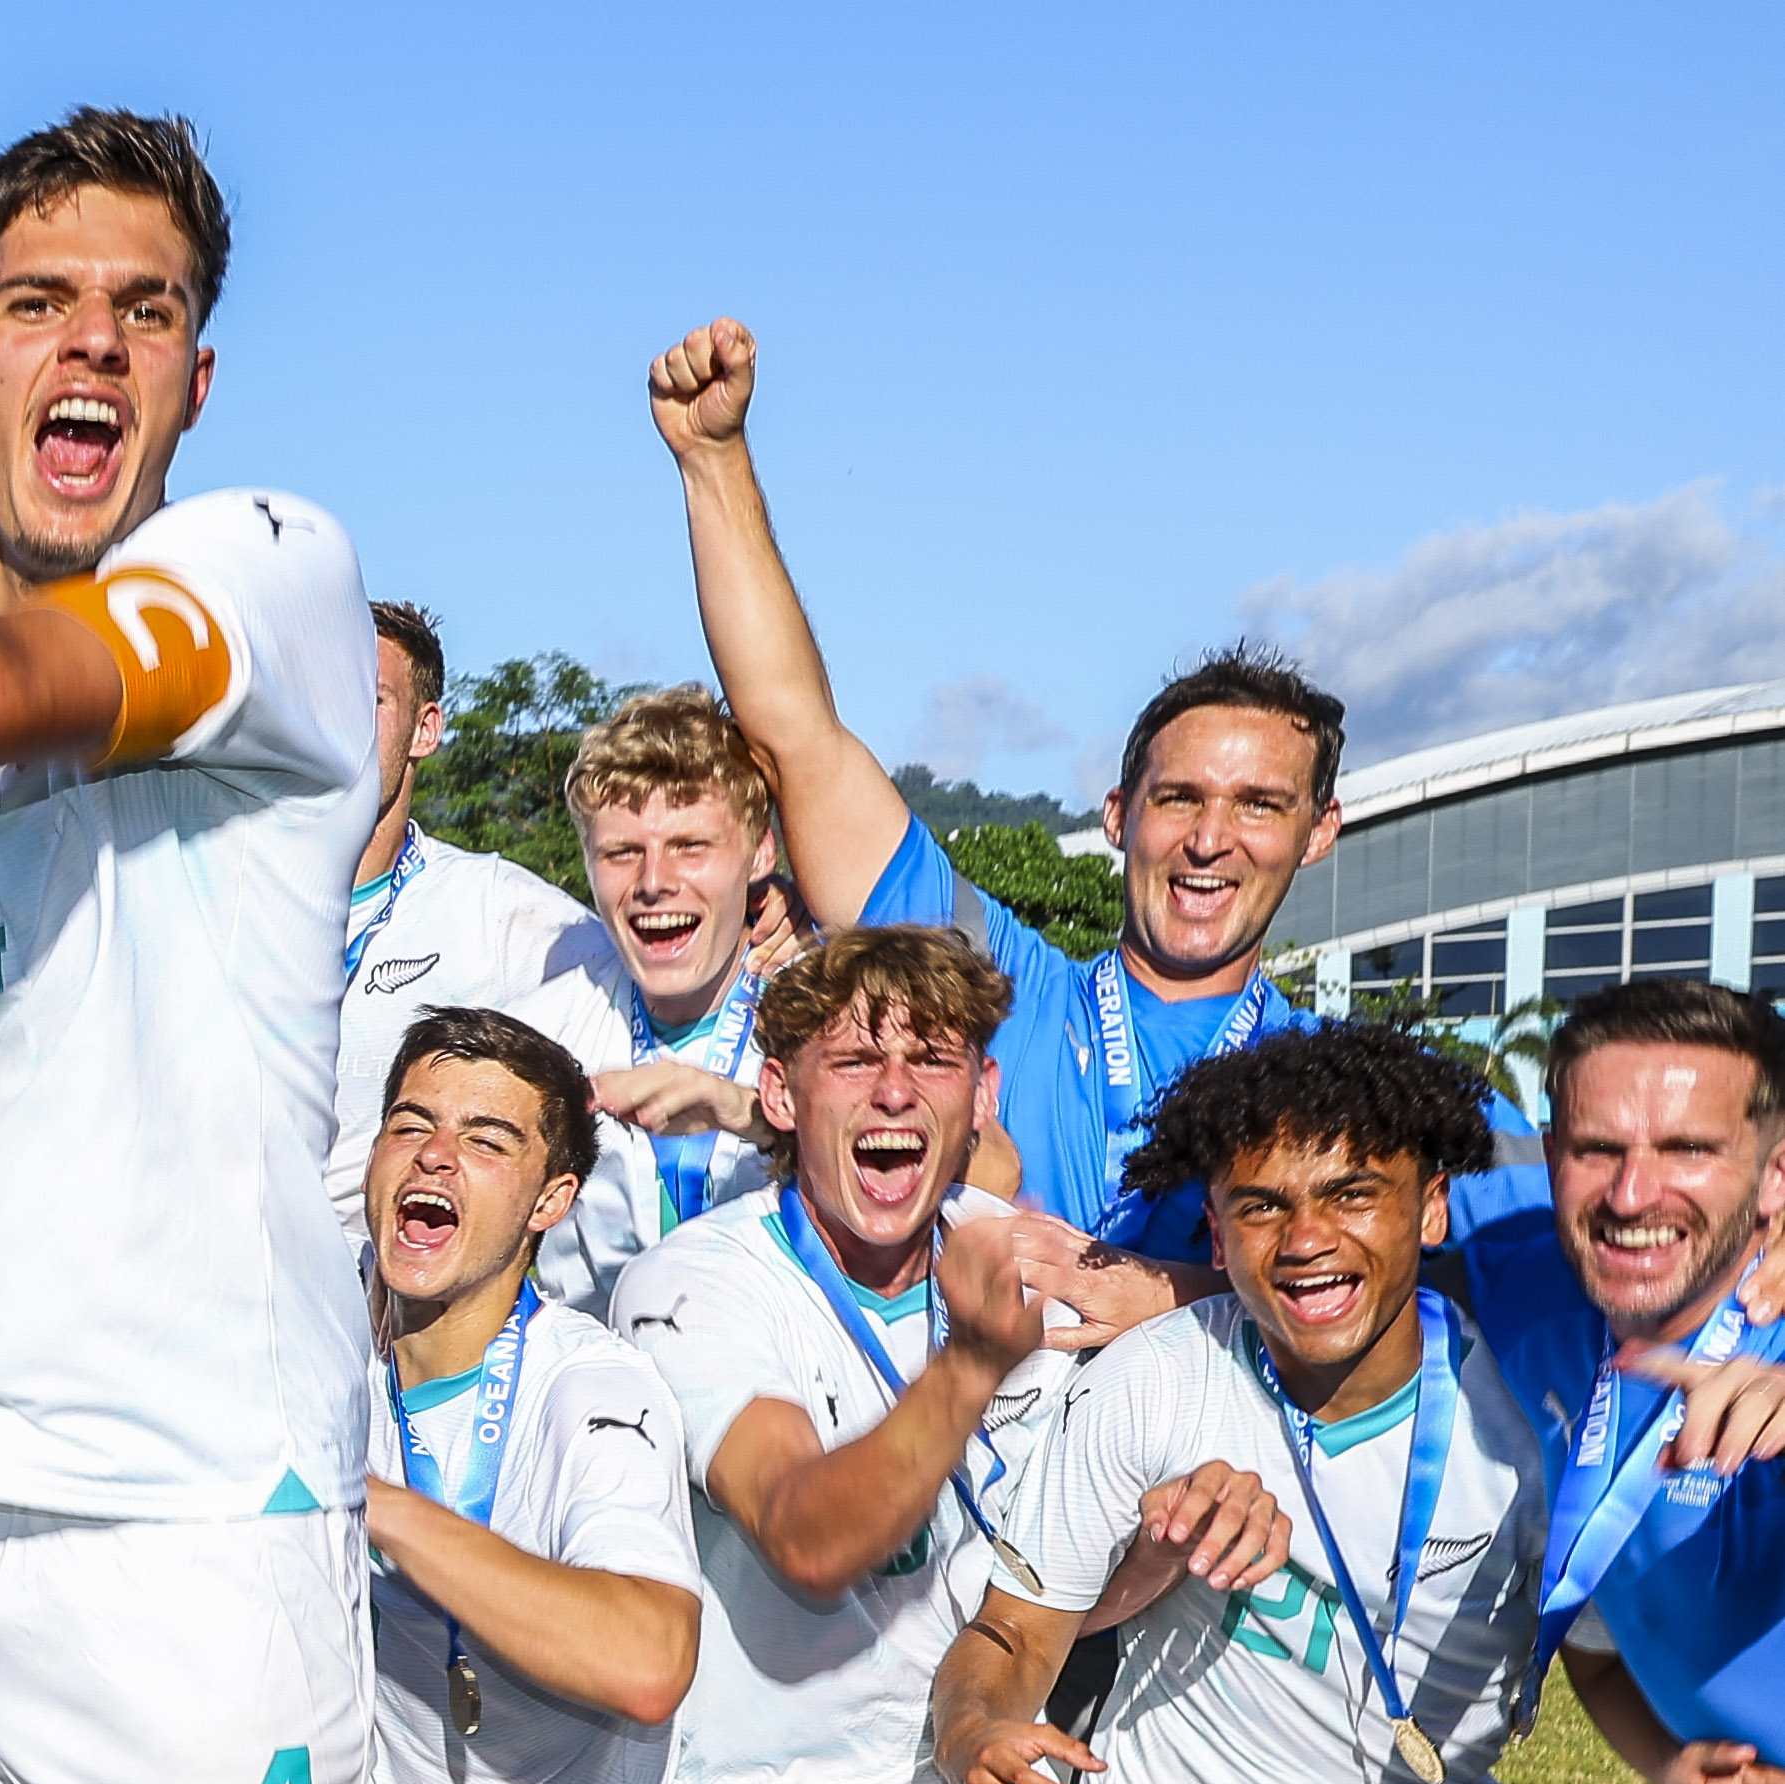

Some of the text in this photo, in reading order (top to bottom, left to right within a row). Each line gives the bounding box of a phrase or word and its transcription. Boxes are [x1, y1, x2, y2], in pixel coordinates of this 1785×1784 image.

[106, 576, 211, 672] C
[708, 1000, 748, 1079] EANIA
[479, 1314, 521, 1444] OCEANIA
[1221, 1551, 1343, 1675] 21
